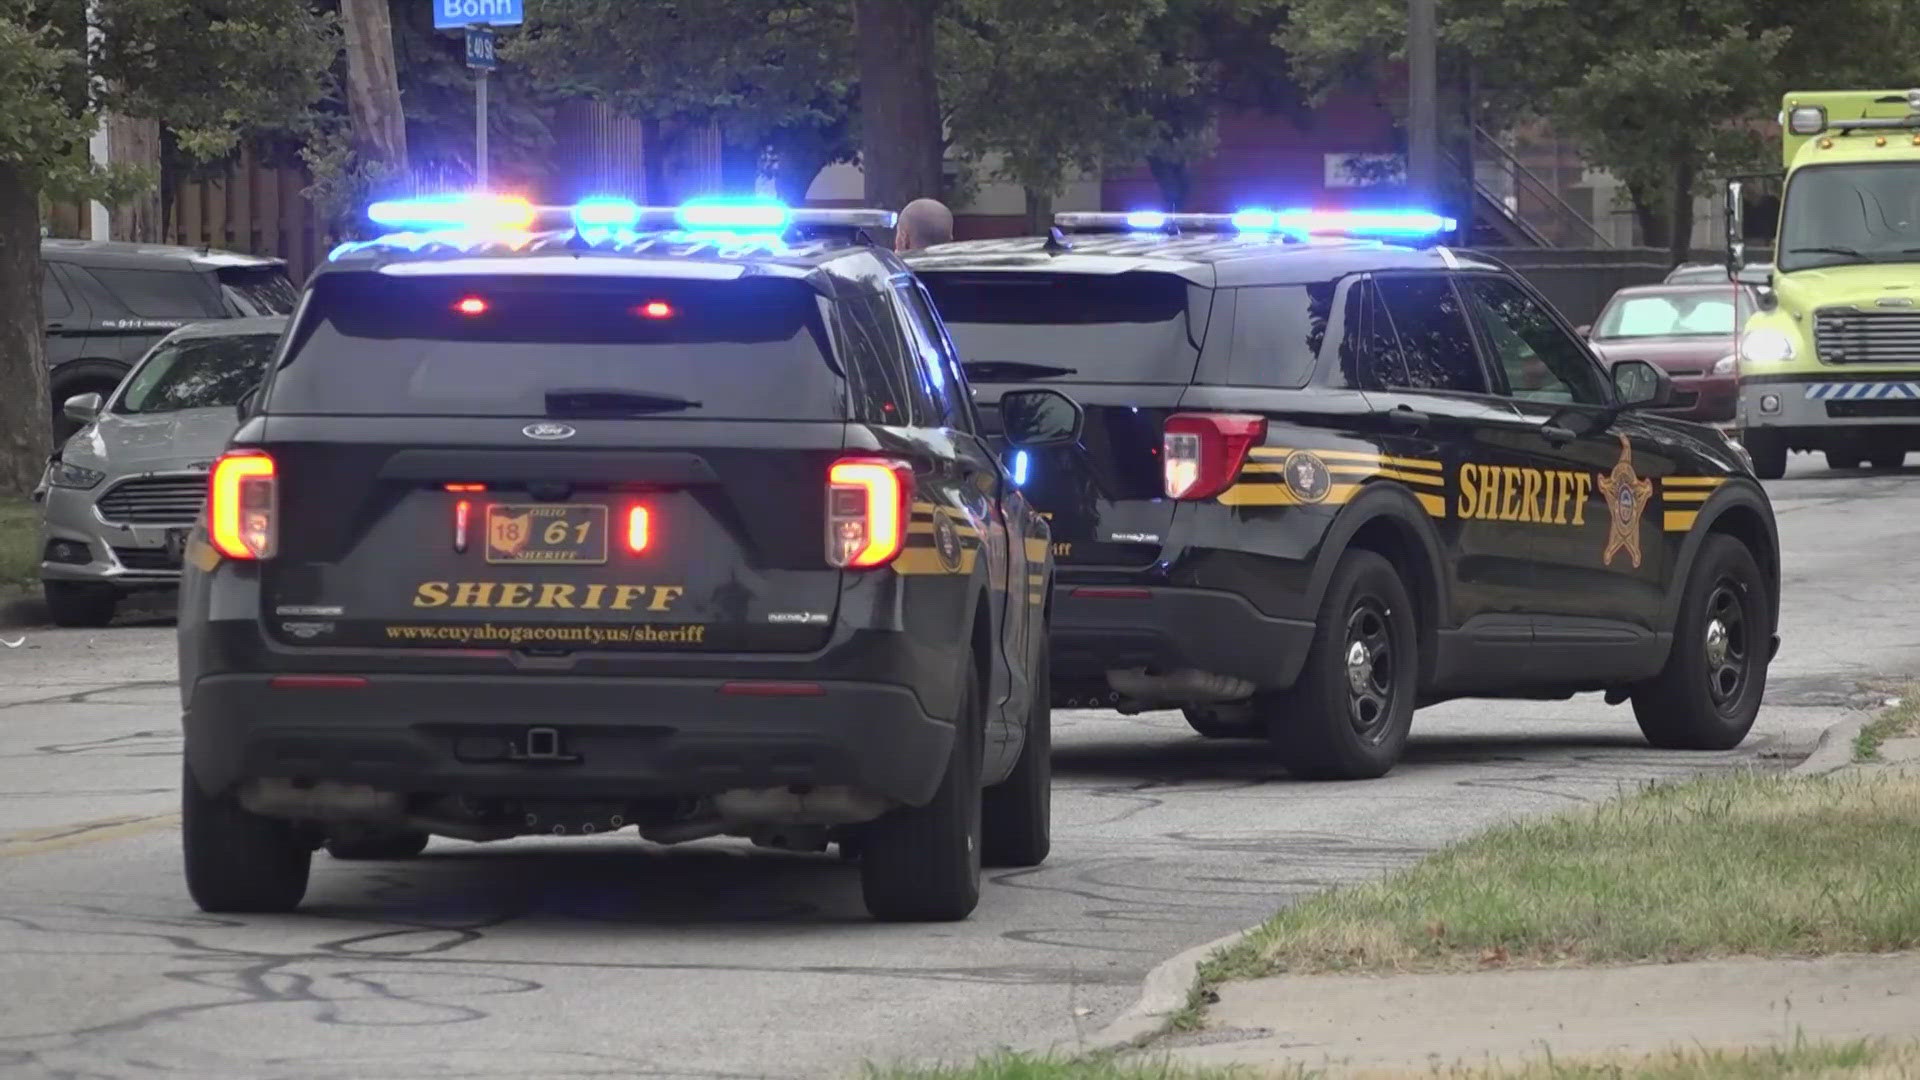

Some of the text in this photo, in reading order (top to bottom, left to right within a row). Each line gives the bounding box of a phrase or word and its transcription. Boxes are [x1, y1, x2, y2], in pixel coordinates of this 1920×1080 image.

[1456, 462, 1592, 526] SHERIFF
[529, 508, 567, 517] OHIO
[496, 520, 592, 545] 18 61
[515, 550, 578, 560] SHERIFF
[413, 581, 684, 612] SHERIFF
[385, 623, 705, 644] www.cuyahogacounty.us/sheriff
